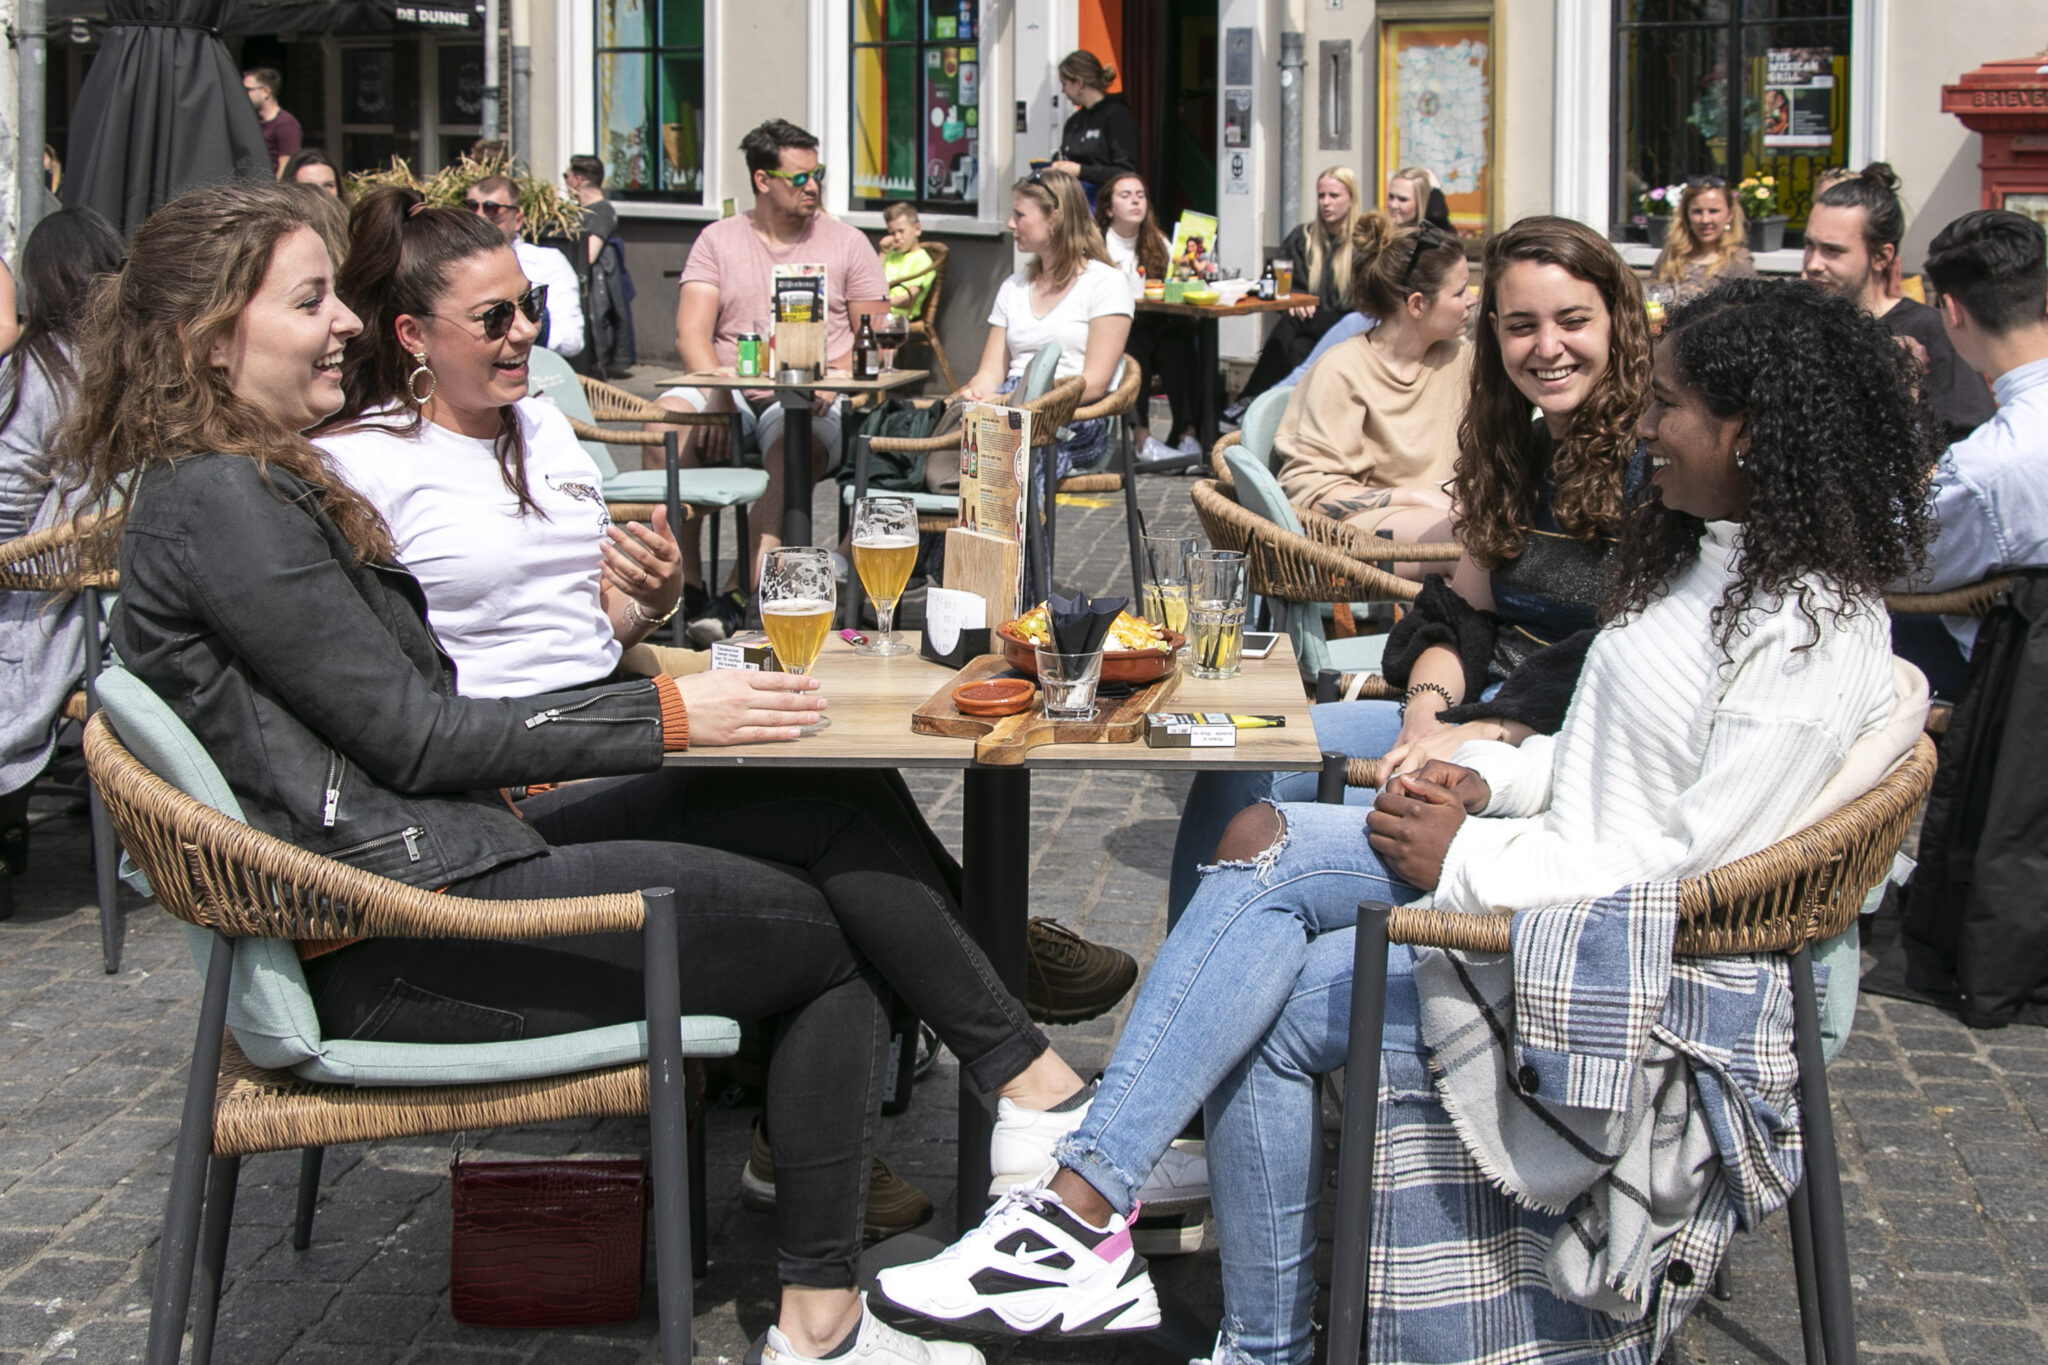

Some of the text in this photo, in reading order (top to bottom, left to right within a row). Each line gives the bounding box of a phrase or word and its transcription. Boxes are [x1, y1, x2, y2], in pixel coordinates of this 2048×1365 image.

[396, 8, 470, 26] DE DUNNE
[1767, 61, 1819, 72] MEXICAN
[1973, 90, 2048, 106] BRIEVE
